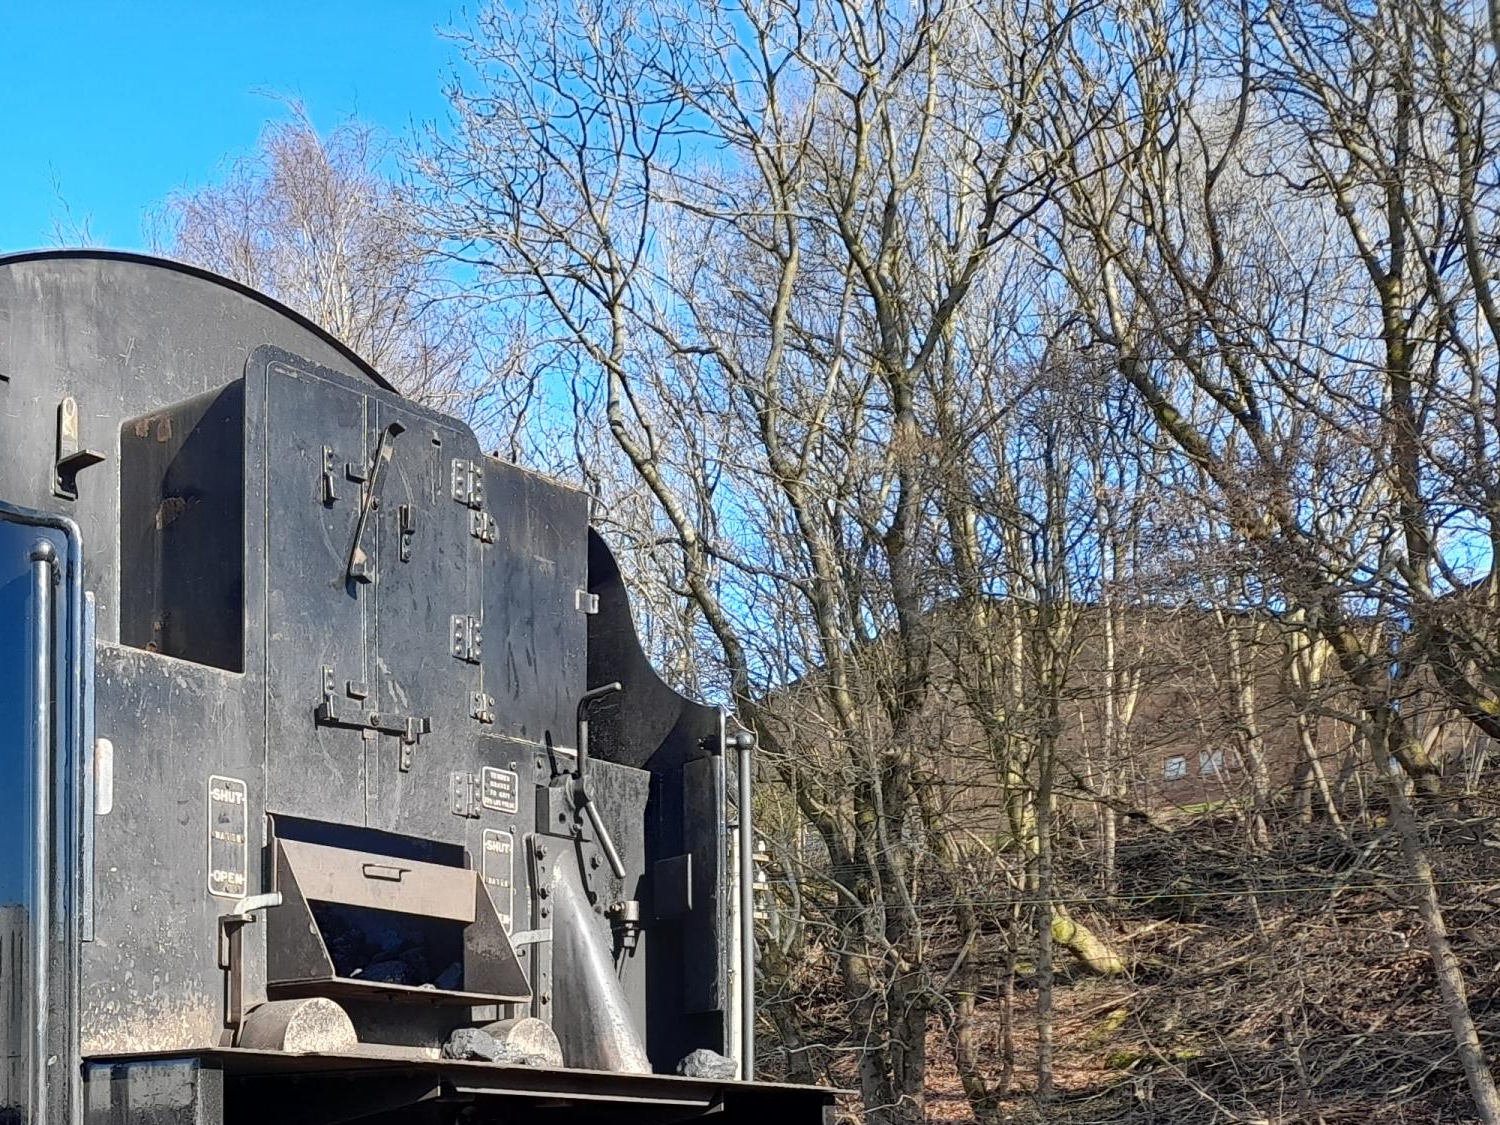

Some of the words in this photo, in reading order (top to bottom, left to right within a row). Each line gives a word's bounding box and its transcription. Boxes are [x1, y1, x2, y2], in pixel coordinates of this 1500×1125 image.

[212, 787, 243, 805] SHUT
[486, 839, 509, 854] SHUT
[213, 869, 243, 885] OPEN
